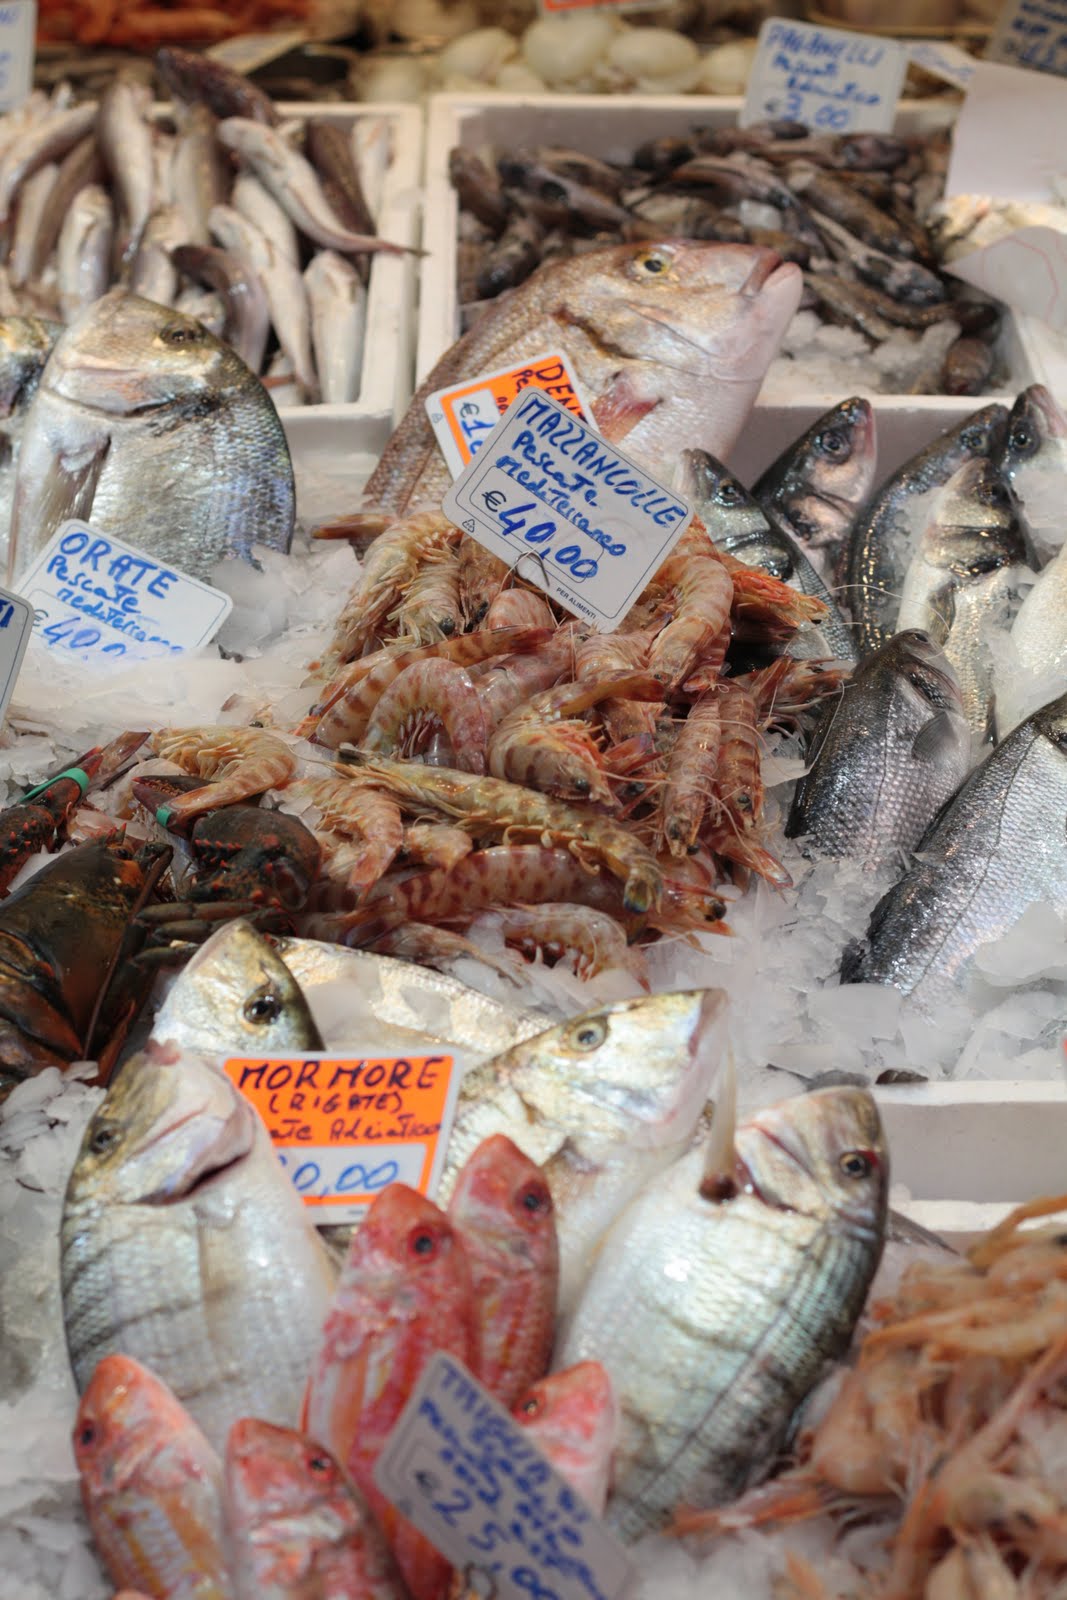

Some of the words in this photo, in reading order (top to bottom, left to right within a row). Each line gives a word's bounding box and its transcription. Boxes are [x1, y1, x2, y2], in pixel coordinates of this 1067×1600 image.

[516, 398, 687, 528] MAZZANCOLLE
[60, 533, 178, 599] ORATE
[556, 587, 569, 600] PER
[568, 597, 597, 620] ALIMENTI
